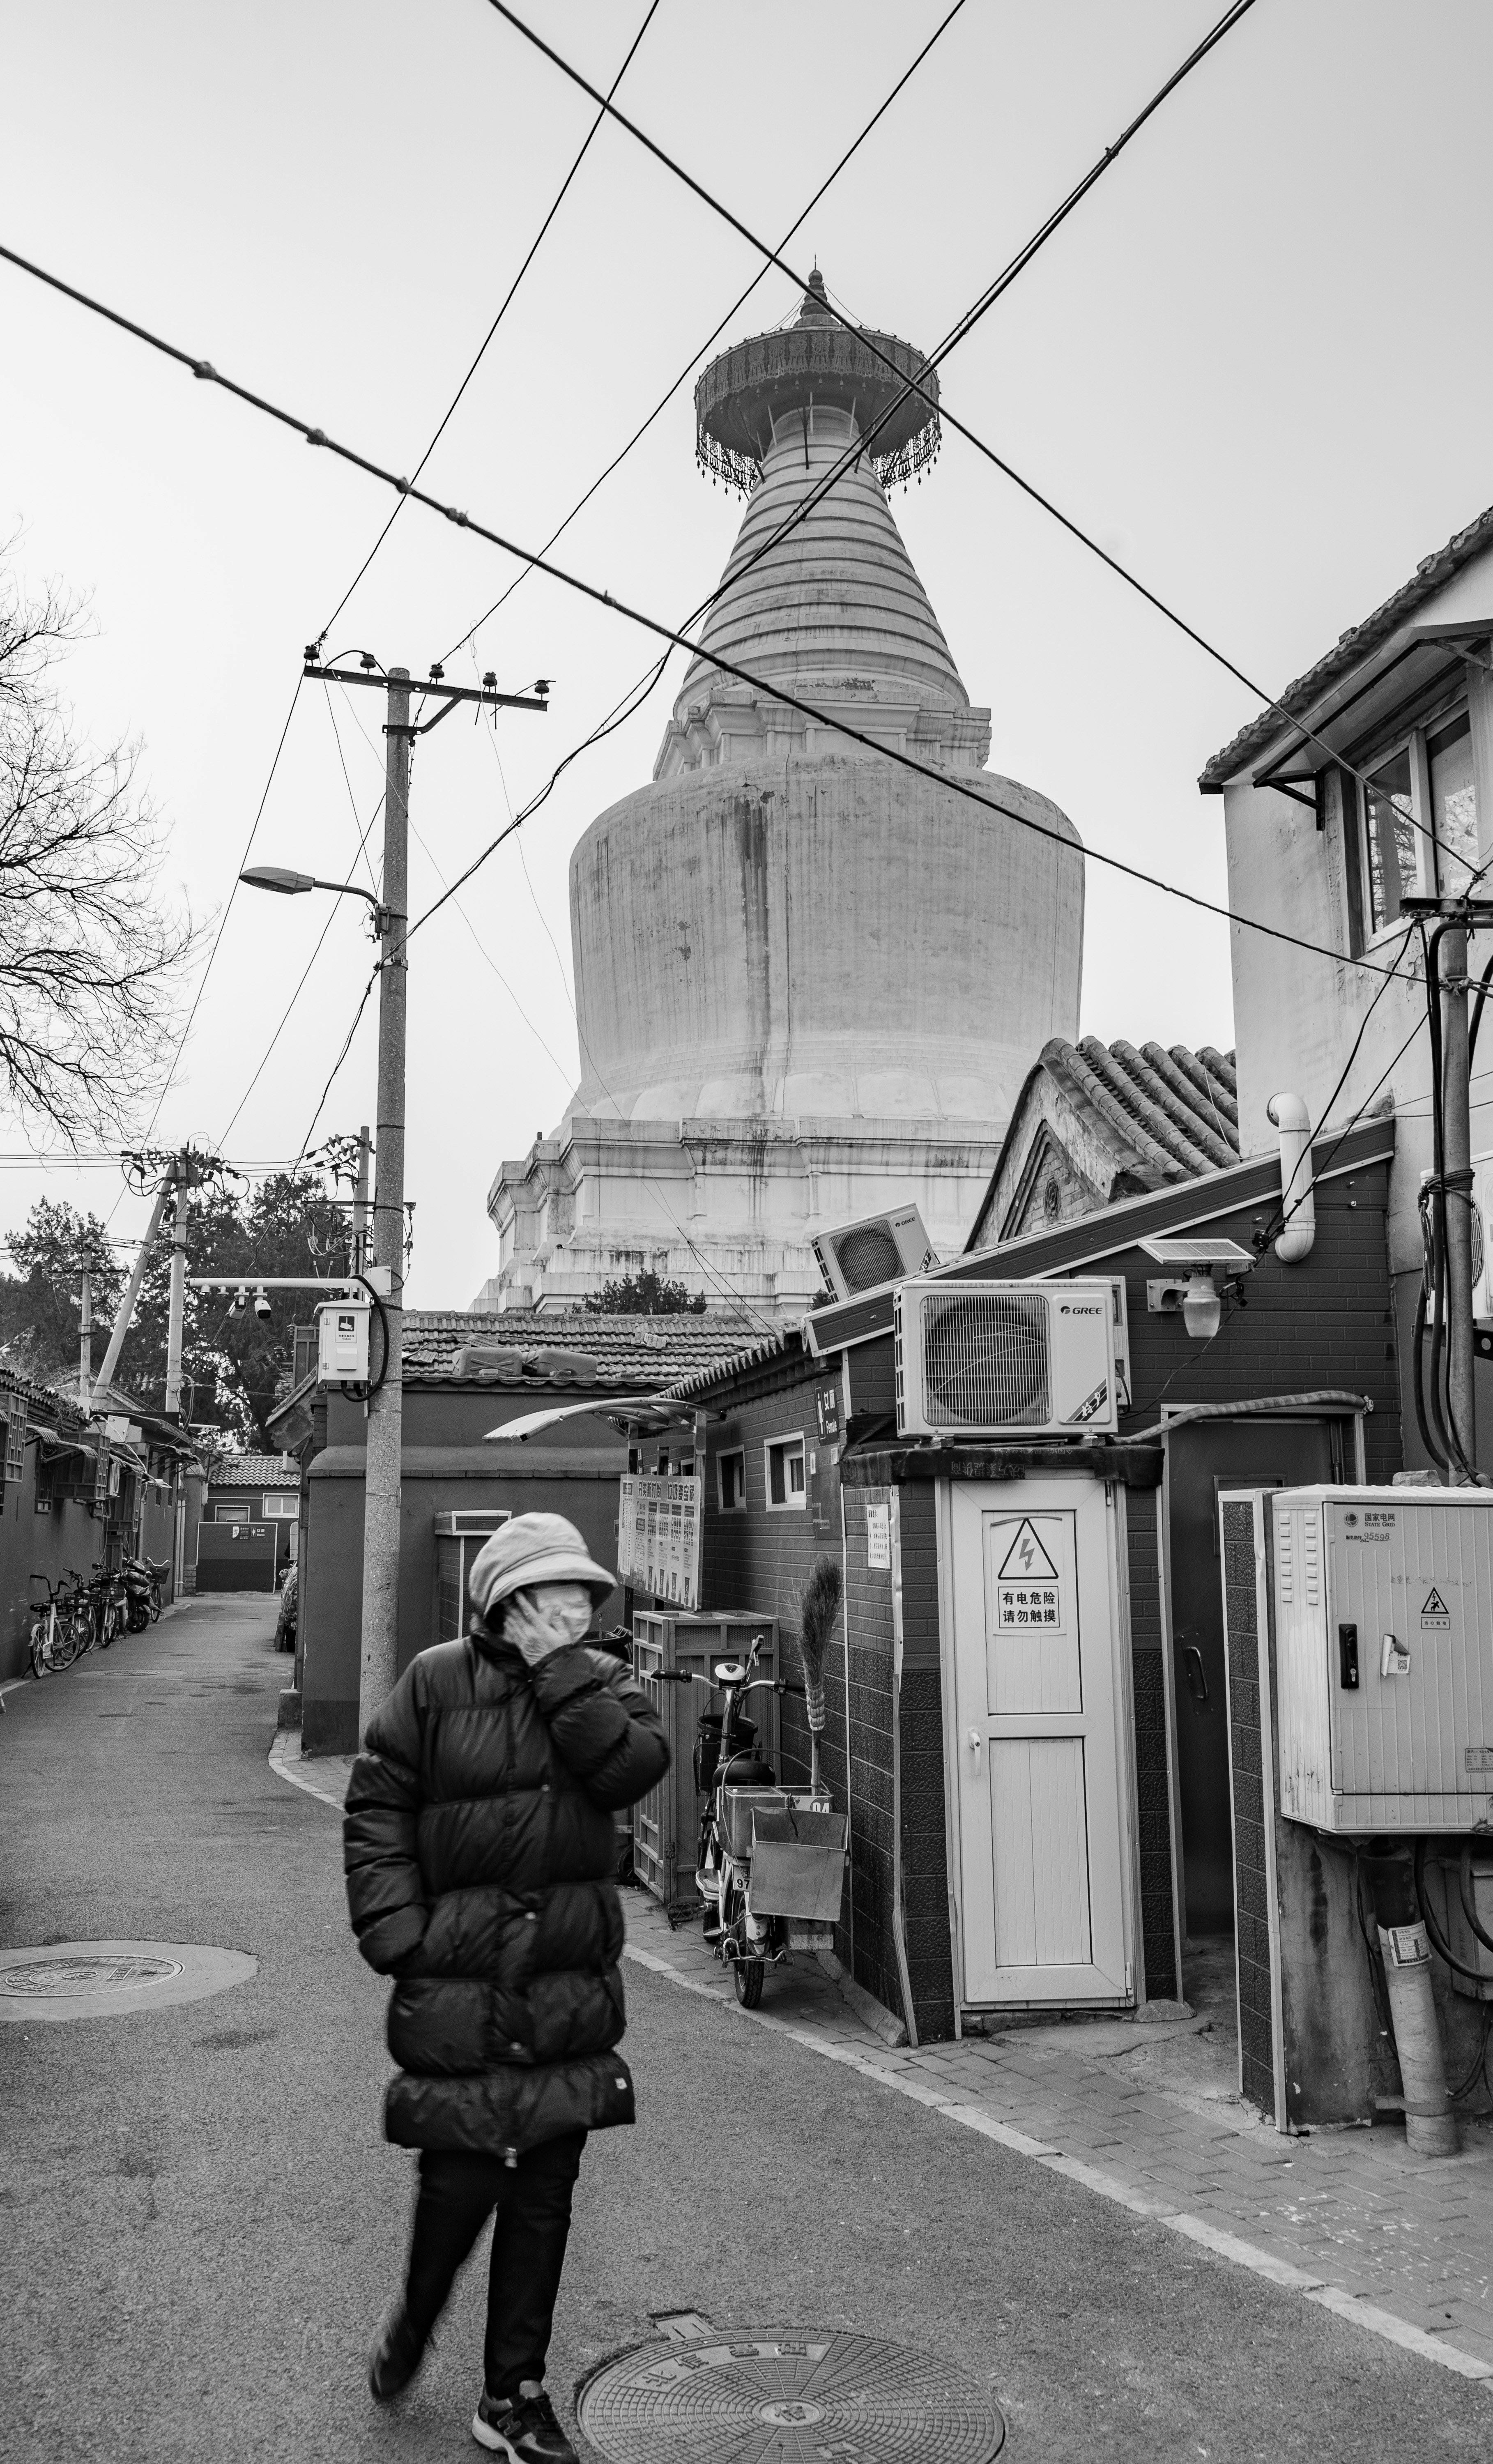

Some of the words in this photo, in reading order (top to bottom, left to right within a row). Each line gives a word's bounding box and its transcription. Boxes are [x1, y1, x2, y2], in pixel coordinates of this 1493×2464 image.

[901, 1217, 916, 1225] GREE
[824, 1389, 835, 1411] 女厕
[826, 1419, 837, 1434] Female
[638, 1482, 661, 1498] 分类新时尚
[667, 1483, 694, 1502] 垃圾变宝藏
[1364, 1513, 1395, 1521] 国家电网
[1364, 1532, 1390, 1541] 95598
[1002, 1592, 1055, 1605] 有电危险
[1003, 1609, 1056, 1623] 请勿触摸
[737, 1878, 750, 1889] 97
